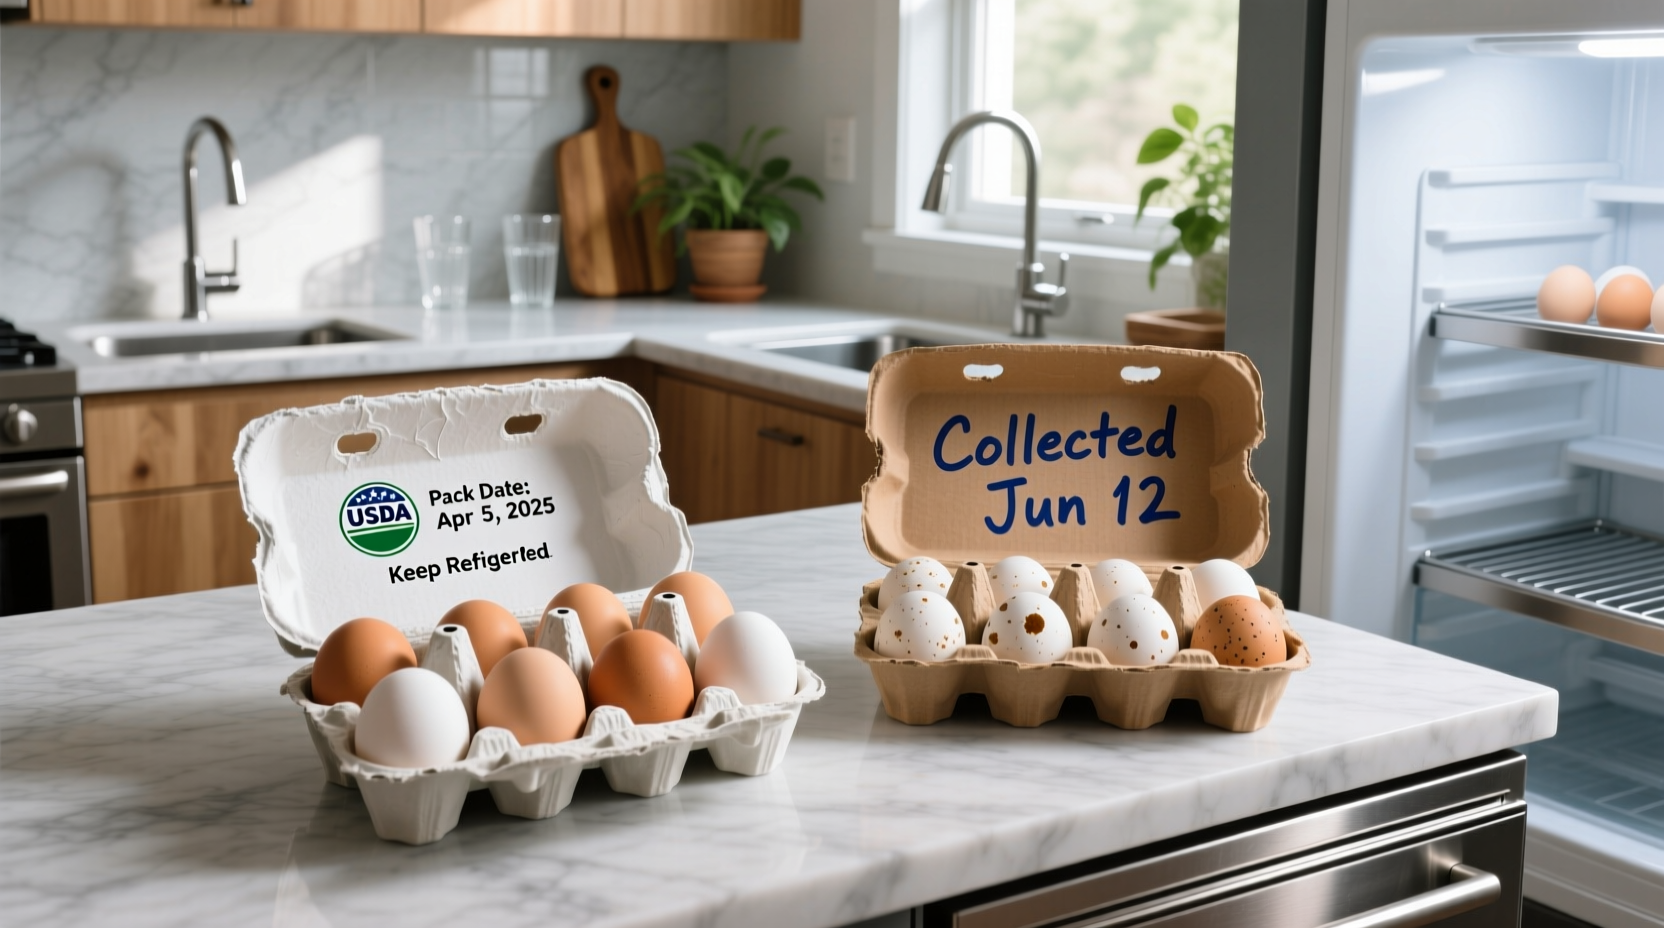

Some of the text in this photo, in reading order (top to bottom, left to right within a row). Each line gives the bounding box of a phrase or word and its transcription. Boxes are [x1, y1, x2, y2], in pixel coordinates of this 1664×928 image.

[933, 404, 1177, 472] Collected
[429, 481, 531, 506] Pack Date:
[984, 475, 1181, 535] Jun 12
[347, 503, 412, 527] USDA
[437, 497, 556, 532] Apr 5, 2025
[388, 563, 442, 584] Keep
